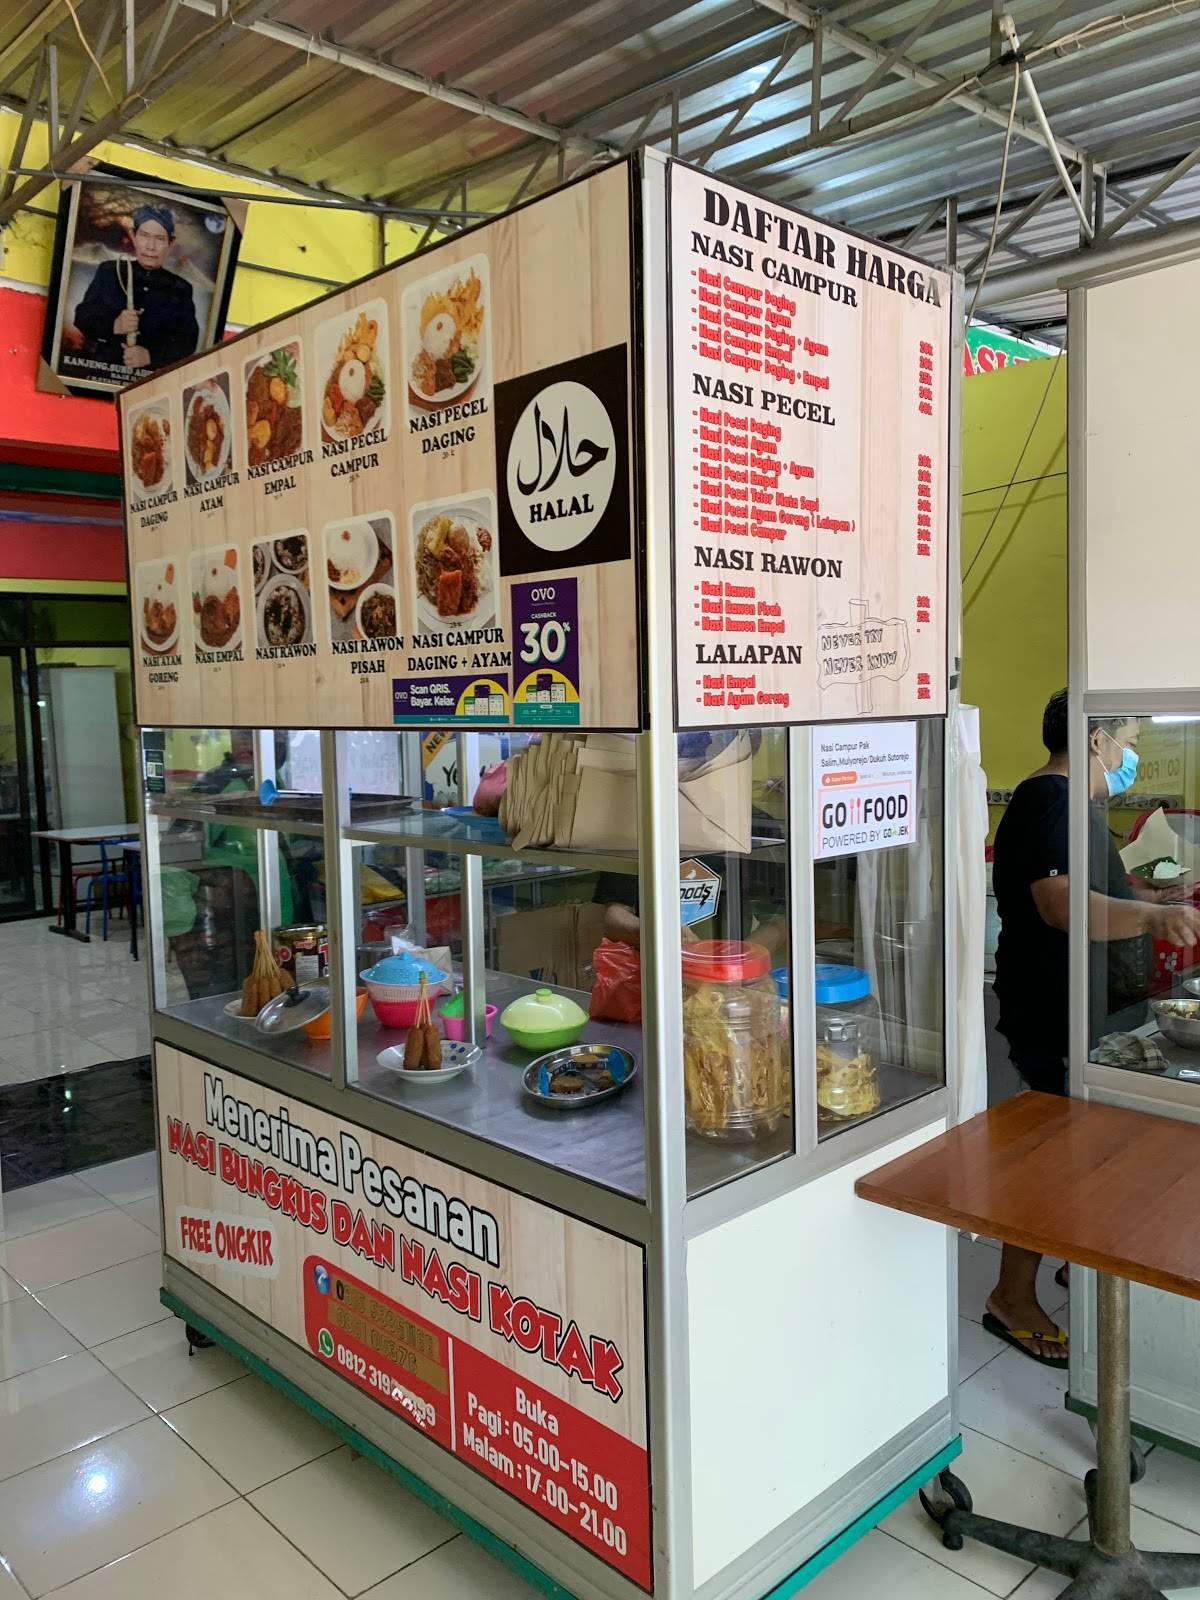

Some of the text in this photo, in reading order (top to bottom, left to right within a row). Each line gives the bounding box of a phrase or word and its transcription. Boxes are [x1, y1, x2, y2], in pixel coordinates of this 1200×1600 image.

[703, 188, 943, 307] DAFTAR HARGA
[691, 231, 858, 307] NASI CAMPUR
[699, 267, 721, 288] Nasi
[724, 276, 763, 301] Campur
[699, 286, 791, 329] Nasi Campur Ayam
[699, 304, 721, 325] Nasi
[724, 312, 763, 337] Campur
[804, 337, 829, 357] Ayam
[699, 322, 721, 343] Nasi
[724, 330, 763, 355] Campur
[699, 341, 722, 361] Nasi
[724, 348, 763, 373] Campur
[693, 373, 836, 426] NASI PECEL
[409, 398, 488, 434] NASI PECEL
[700, 407, 722, 425] Nasi
[750, 418, 781, 442] Daging
[322, 428, 388, 459] NASI PECEL
[422, 426, 476, 454] DAGING
[700, 425, 722, 443] Nasi
[517, 401, 609, 496] حلال
[700, 443, 722, 462] Nasi
[247, 449, 314, 480] NASI CAMPUR
[331, 453, 379, 477] CAMPUR
[700, 462, 722, 479] Nasi
[183, 472, 240, 498] NASI CAMPUR
[264, 475, 296, 495] EMPAL
[700, 480, 722, 497] Nasi
[129, 491, 178, 513] NASI CAMPUR
[200, 495, 224, 512] AYAM
[530, 494, 594, 524] HALAL
[700, 498, 722, 515] Nasi
[140, 511, 168, 528] DAGING
[700, 517, 722, 533] Nasi
[750, 523, 787, 543] Campur
[694, 546, 843, 578] NASI RAWON
[531, 587, 556, 601] OVO
[701, 581, 722, 597] Nasi
[530, 611, 557, 620] CASHBACK
[701, 599, 723, 614] Nasi
[702, 616, 723, 631] Nasi
[332, 636, 405, 655] NASI RAWON
[412, 628, 504, 649] NASI CAMPUR
[520, 620, 571, 664] 30%
[821, 628, 883, 652] NEVER TRY
[143, 654, 182, 668] NASI AYAM
[195, 649, 245, 665] NASI EMPAL
[256, 643, 317, 660] NASI RAWON
[408, 651, 512, 671] DAGING + AYAM
[696, 644, 802, 664] LALAPAN
[351, 659, 385, 675] PISAH
[823, 655, 863, 676] NEVER
[148, 671, 178, 683] GORENG
[703, 674, 724, 689] Nasi
[395, 691, 408, 700] OVO
[410, 683, 451, 694] Scan QRIS.
[703, 691, 725, 706] Nasi
[821, 743, 834, 752] Nasi
[835, 743, 858, 752] Campur
[822, 794, 908, 829] GO FOOD
[822, 831, 867, 849] POWERED
[869, 830, 881, 842] BY
[204, 1072, 500, 1268] Menerima Pesanan
[180, 1216, 274, 1267] FREE ONGKIR
[167, 1115, 216, 1175] NASI
[218, 1142, 329, 1235] BUNGKUS
[331, 1199, 396, 1272] DAN
[400, 1234, 482, 1322] NASI
[488, 1281, 624, 1403] KOTAK
[337, 1344, 367, 1380] 0812
[515, 1387, 559, 1436] Buka
[467, 1391, 502, 1437] Pagi
[512, 1420, 618, 1511] 05.00-15.00
[463, 1422, 514, 1479] Malam
[525, 1464, 627, 1556] 17.00-21.00
